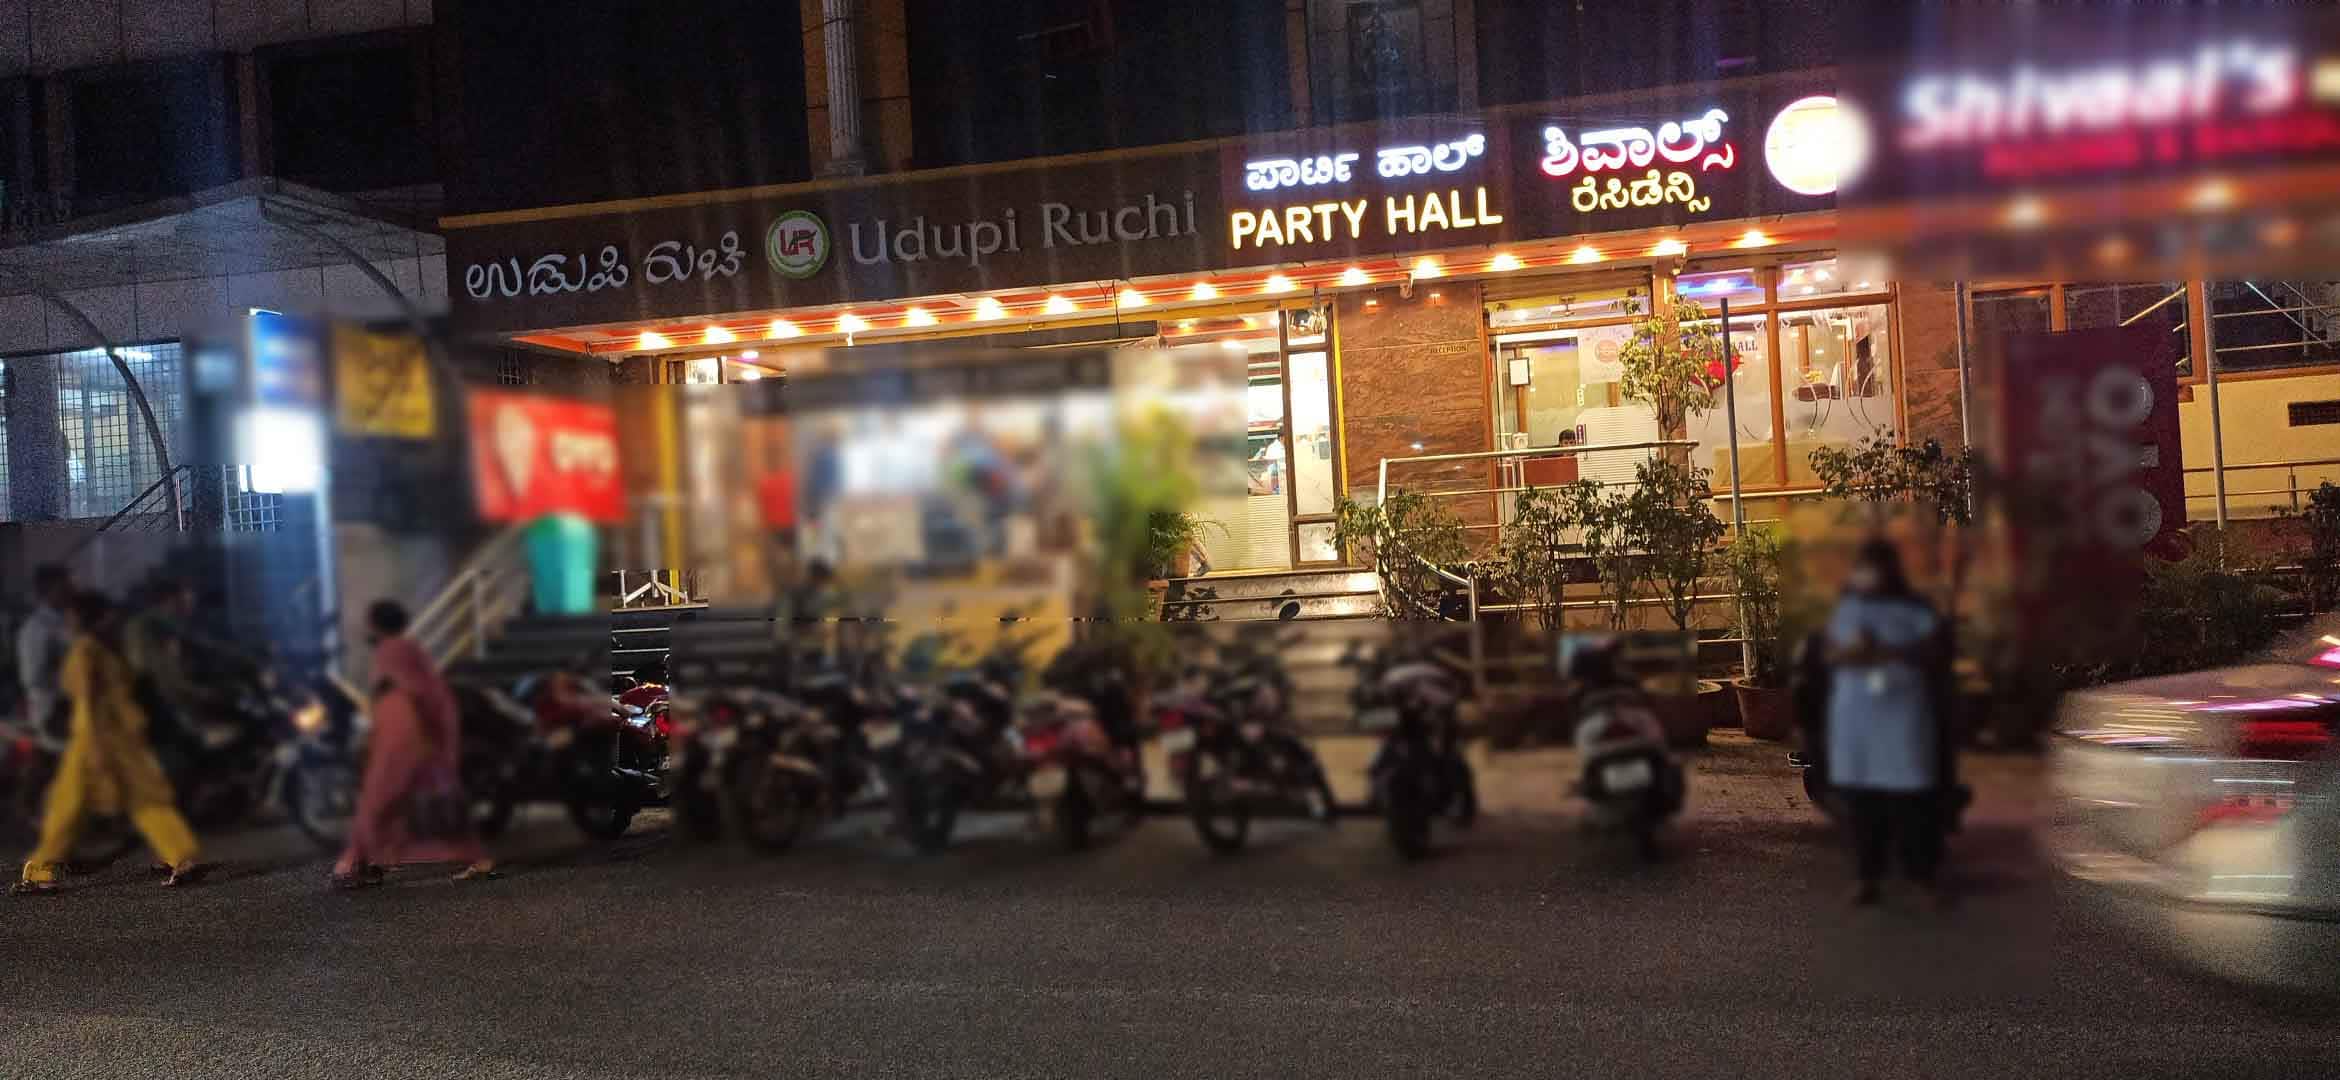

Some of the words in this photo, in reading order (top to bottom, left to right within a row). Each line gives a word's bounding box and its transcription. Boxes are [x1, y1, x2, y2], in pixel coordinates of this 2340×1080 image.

[1376, 133, 1486, 178] ಹಾಲ್
[849, 207, 1021, 267] Udupi
[1041, 189, 1200, 248] Ruchi
[1230, 199, 1368, 250] PARTY
[1386, 186, 1504, 236] HALL
[466, 244, 630, 299] ಉಡುಪಿ
[643, 230, 746, 283] ರುಚಿ
